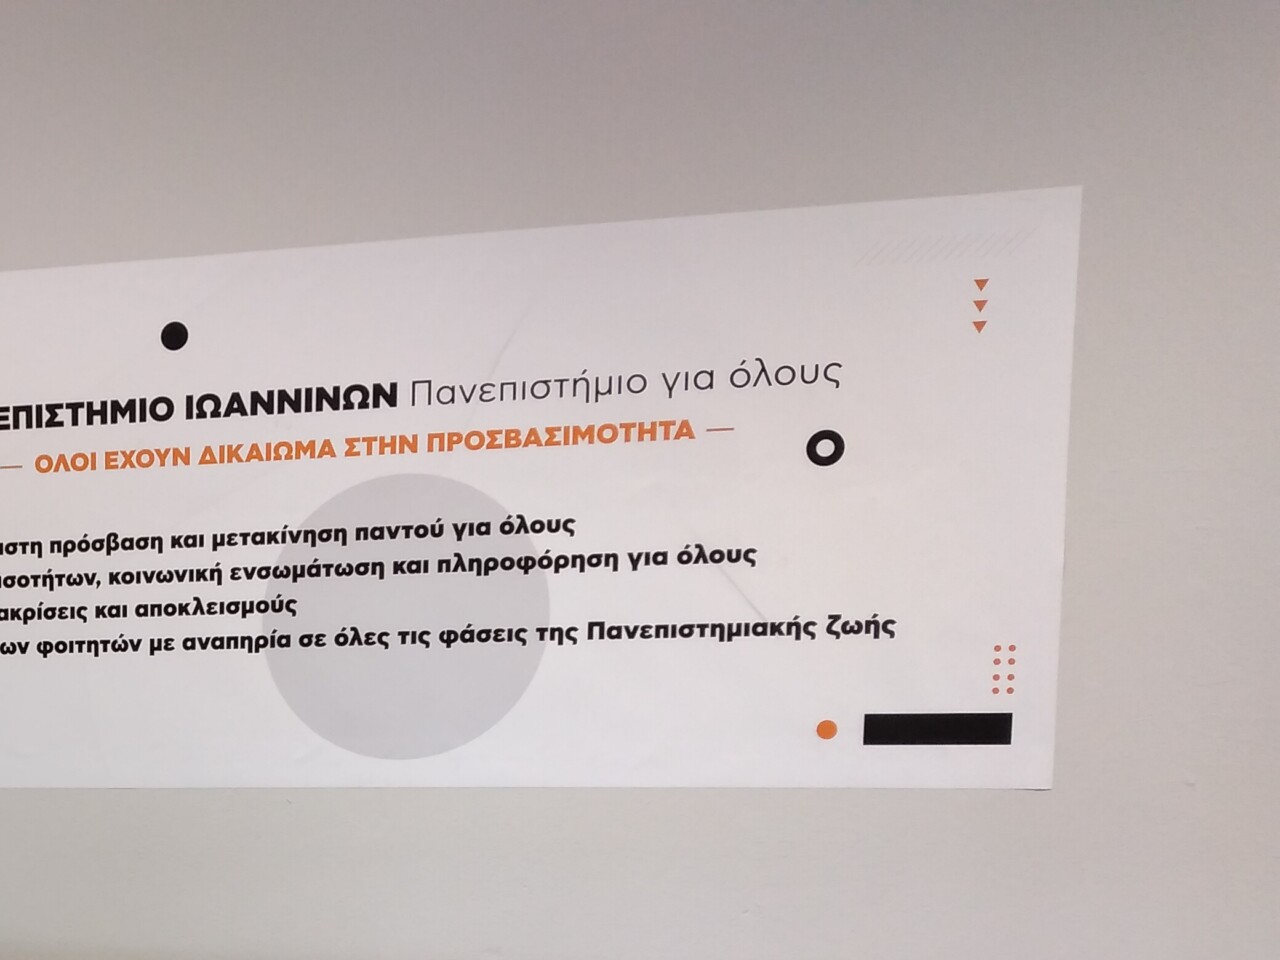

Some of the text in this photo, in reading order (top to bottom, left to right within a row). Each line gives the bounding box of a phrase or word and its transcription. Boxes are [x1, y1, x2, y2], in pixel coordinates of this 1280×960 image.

[186, 382, 397, 419] ΙΩΑΝΝΙΝΩΝ
[412, 369, 647, 406] Πανεπιστήμιο
[662, 370, 713, 398] για
[730, 358, 842, 388] όλους
[35, 420, 694, 473] ΟΛΟΙ ΕΧΟΥΝ ΔΙΚΑΙΩΜΑ ΣΤΗΝ ΠΡΟΣΒΑΣΙΜΟΤΗΤΑ
[50, 533, 163, 557] πρόσβαση
[171, 535, 204, 548] και
[212, 525, 347, 551] μετακίνηση
[356, 518, 444, 541] παντού
[452, 522, 491, 541] για
[500, 515, 575, 536] όλους
[109, 562, 222, 585] κοινωνική
[230, 558, 384, 583] ενσωμάτωση
[393, 560, 429, 574] και
[438, 550, 618, 576] πληροφόρηση
[628, 551, 667, 571] για
[677, 544, 757, 567] όλους
[95, 605, 127, 618] και
[135, 594, 297, 618] αποκλεισμούς
[37, 634, 142, 657] φοιτητών
[150, 638, 175, 656] με
[183, 629, 291, 653] αναπηρία
[299, 634, 326, 647] σε
[334, 627, 390, 649] όλες
[398, 631, 431, 648] τις
[439, 624, 528, 648] φάσεις
[536, 627, 578, 645] της
[588, 615, 817, 642] Πανεπιστημιακής
[826, 614, 896, 639] ζωής
